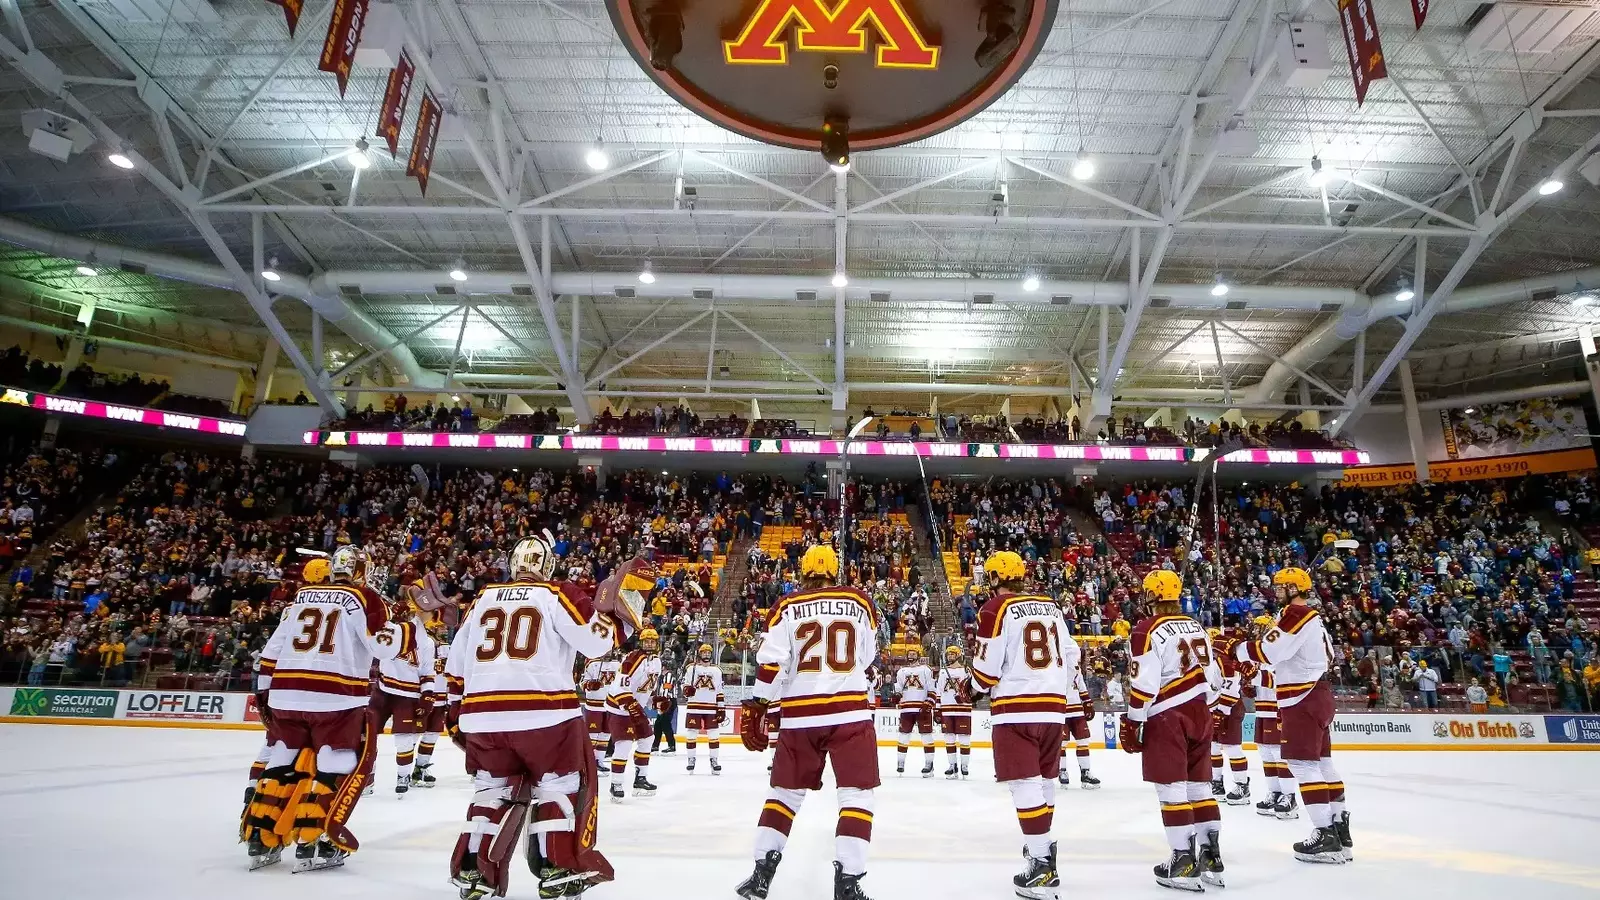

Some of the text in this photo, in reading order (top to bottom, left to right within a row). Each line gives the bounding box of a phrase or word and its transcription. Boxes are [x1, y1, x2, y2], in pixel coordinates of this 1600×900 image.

[45, 397, 86, 414] WIN
[105, 405, 144, 422] WIN
[163, 413, 199, 430] WIN
[572, 437, 743, 452] WIN WIN WIN WIN
[790, 441, 820, 453] WIN
[884, 442, 914, 455] WIN
[930, 443, 961, 456] WIN
[1007, 444, 1177, 460] WIN WIN WIN WIN
[1268, 451, 1298, 463] WIN
[1312, 451, 1343, 463] WIN
[1343, 460, 1529, 483] OPHER HOEY 1947-1970
[496, 587, 534, 602] WIESE
[292, 607, 342, 655] 31
[475, 605, 544, 663] 30
[793, 619, 858, 675] 20
[1022, 620, 1064, 671] 81
[619, 676, 631, 687] 16
[53, 695, 115, 706] securian
[127, 693, 225, 713] LOFFLER
[51, 706, 94, 714] FINANCIAL
[1334, 721, 1412, 735] Huntington Bank
[1450, 720, 1517, 738] Old Dutch
[333, 774, 366, 823] VAUGHN
